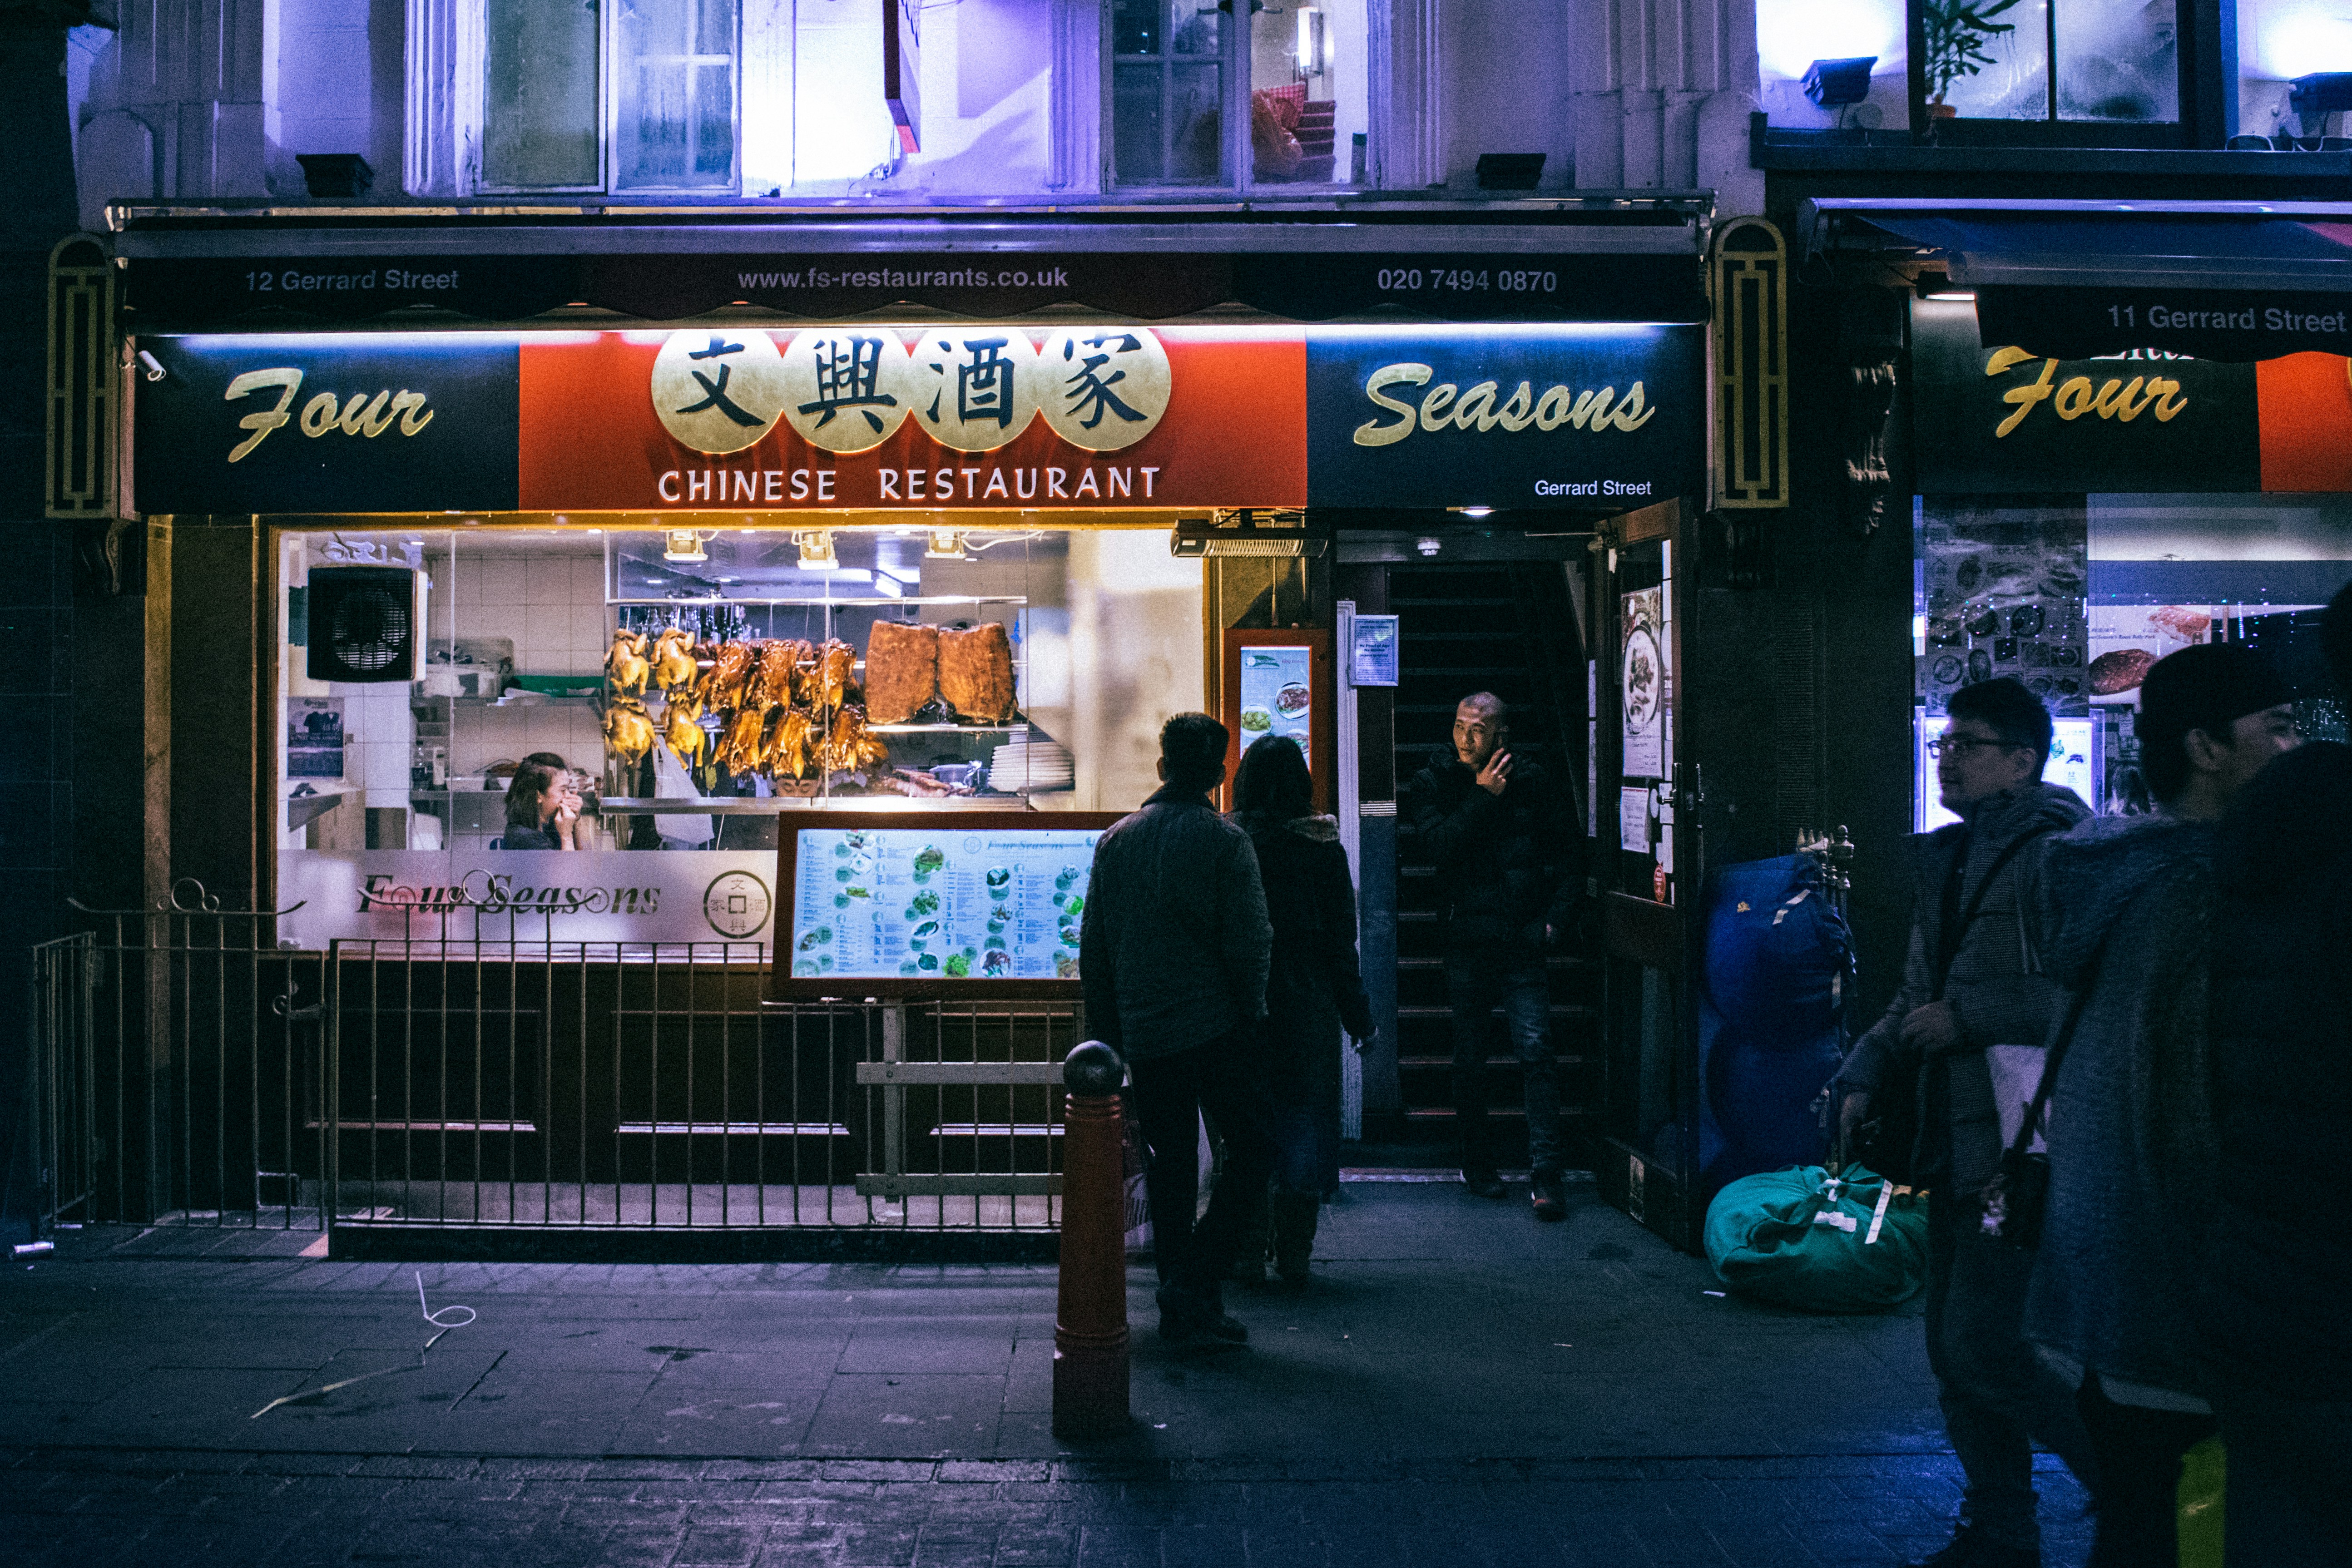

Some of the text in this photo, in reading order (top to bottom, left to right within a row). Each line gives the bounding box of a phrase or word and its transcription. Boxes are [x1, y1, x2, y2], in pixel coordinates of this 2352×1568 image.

[246, 269, 459, 291] 12 Gerrard Street
[738, 267, 1069, 288] www.fs-restaurants.co.uk
[1377, 269, 1557, 292] 020 7494 0870
[2108, 305, 2347, 332] 11 Gerrard Street
[675, 333, 1149, 434] 文興酒家
[1986, 346, 2188, 438] Four
[224, 367, 434, 463] Four
[1353, 362, 1655, 447] Seasons
[658, 466, 1161, 501] CHINESE RESTAURANT
[1535, 480, 1652, 495] Gerrard Street
[356, 874, 660, 914] Four Seasons
[731, 878, 745, 890] 文
[710, 899, 725, 912] 家
[749, 899, 766, 911] 酒
